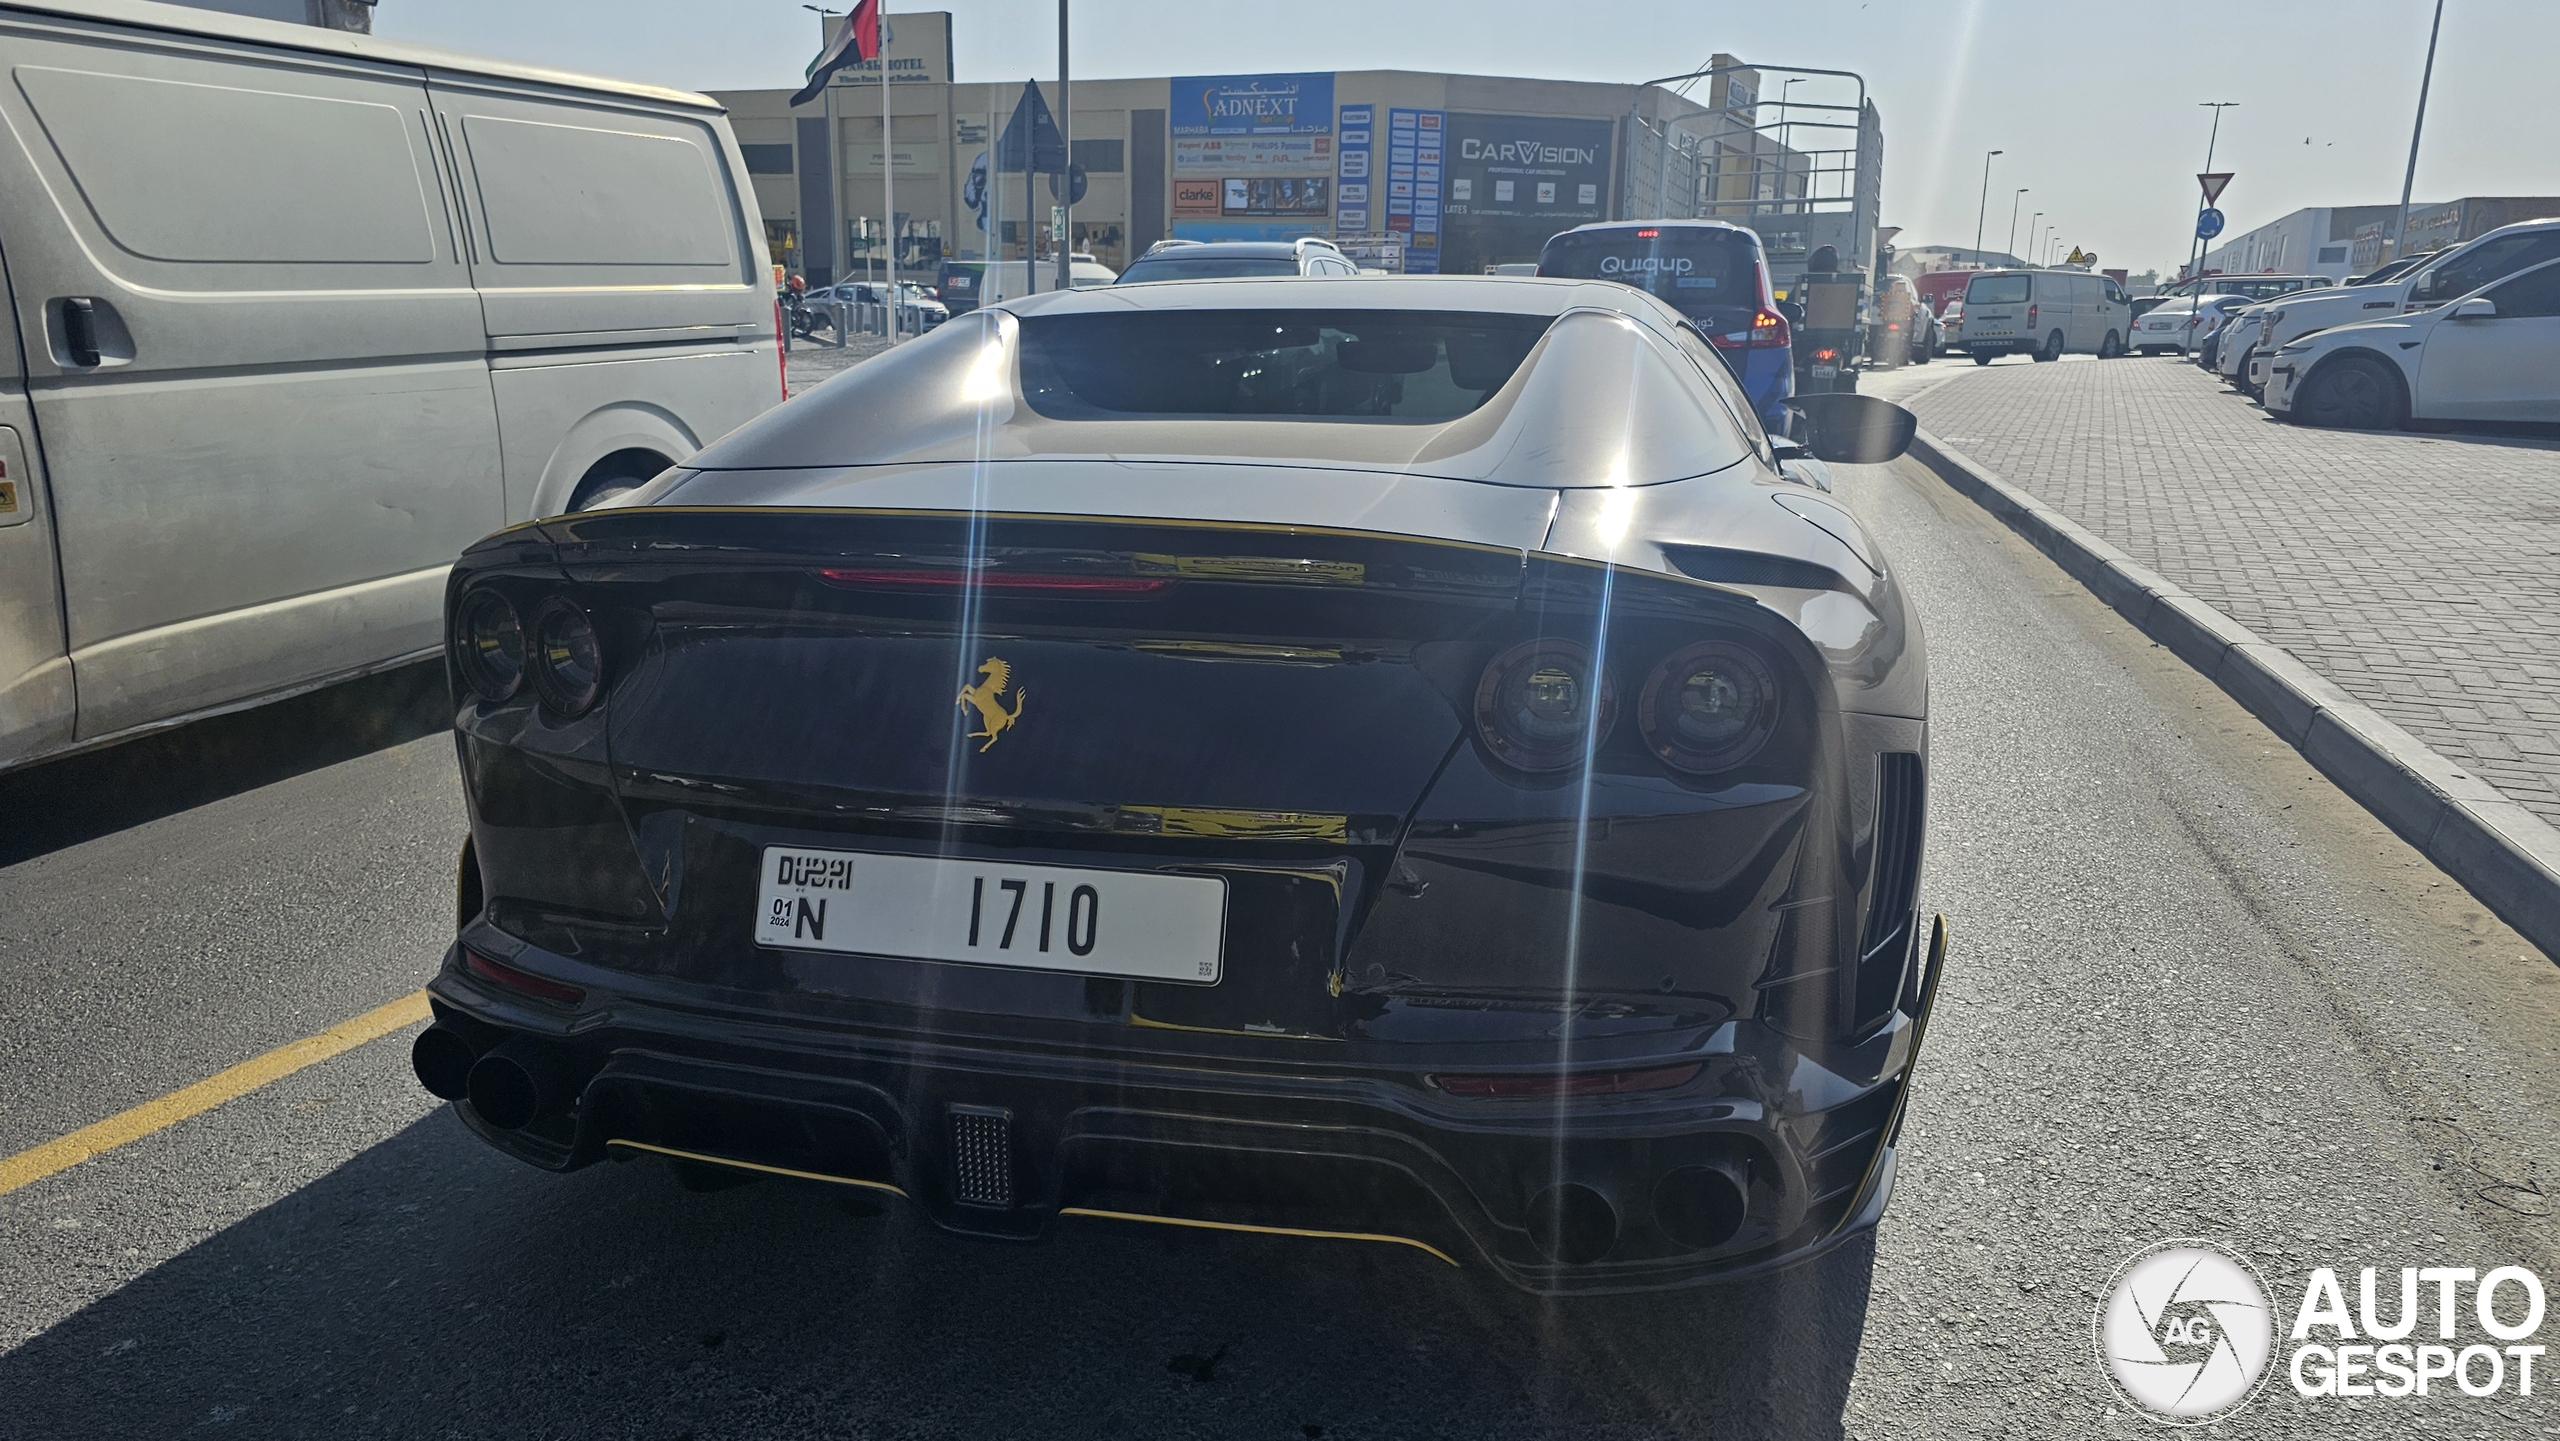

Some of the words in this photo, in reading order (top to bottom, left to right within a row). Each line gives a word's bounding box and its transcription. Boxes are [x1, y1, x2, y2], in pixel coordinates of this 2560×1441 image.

[1212, 98, 1298, 117] ADNEXT
[1174, 125, 1209, 134] MARHABA
[1203, 141, 1222, 150] ABB
[1179, 188, 1214, 201] clarke
[1600, 256, 1692, 276] Quiqup
[773, 898, 793, 917] 01
[968, 875, 1099, 957] 1710
[770, 916, 790, 928] 2024
[795, 896, 827, 941] N
